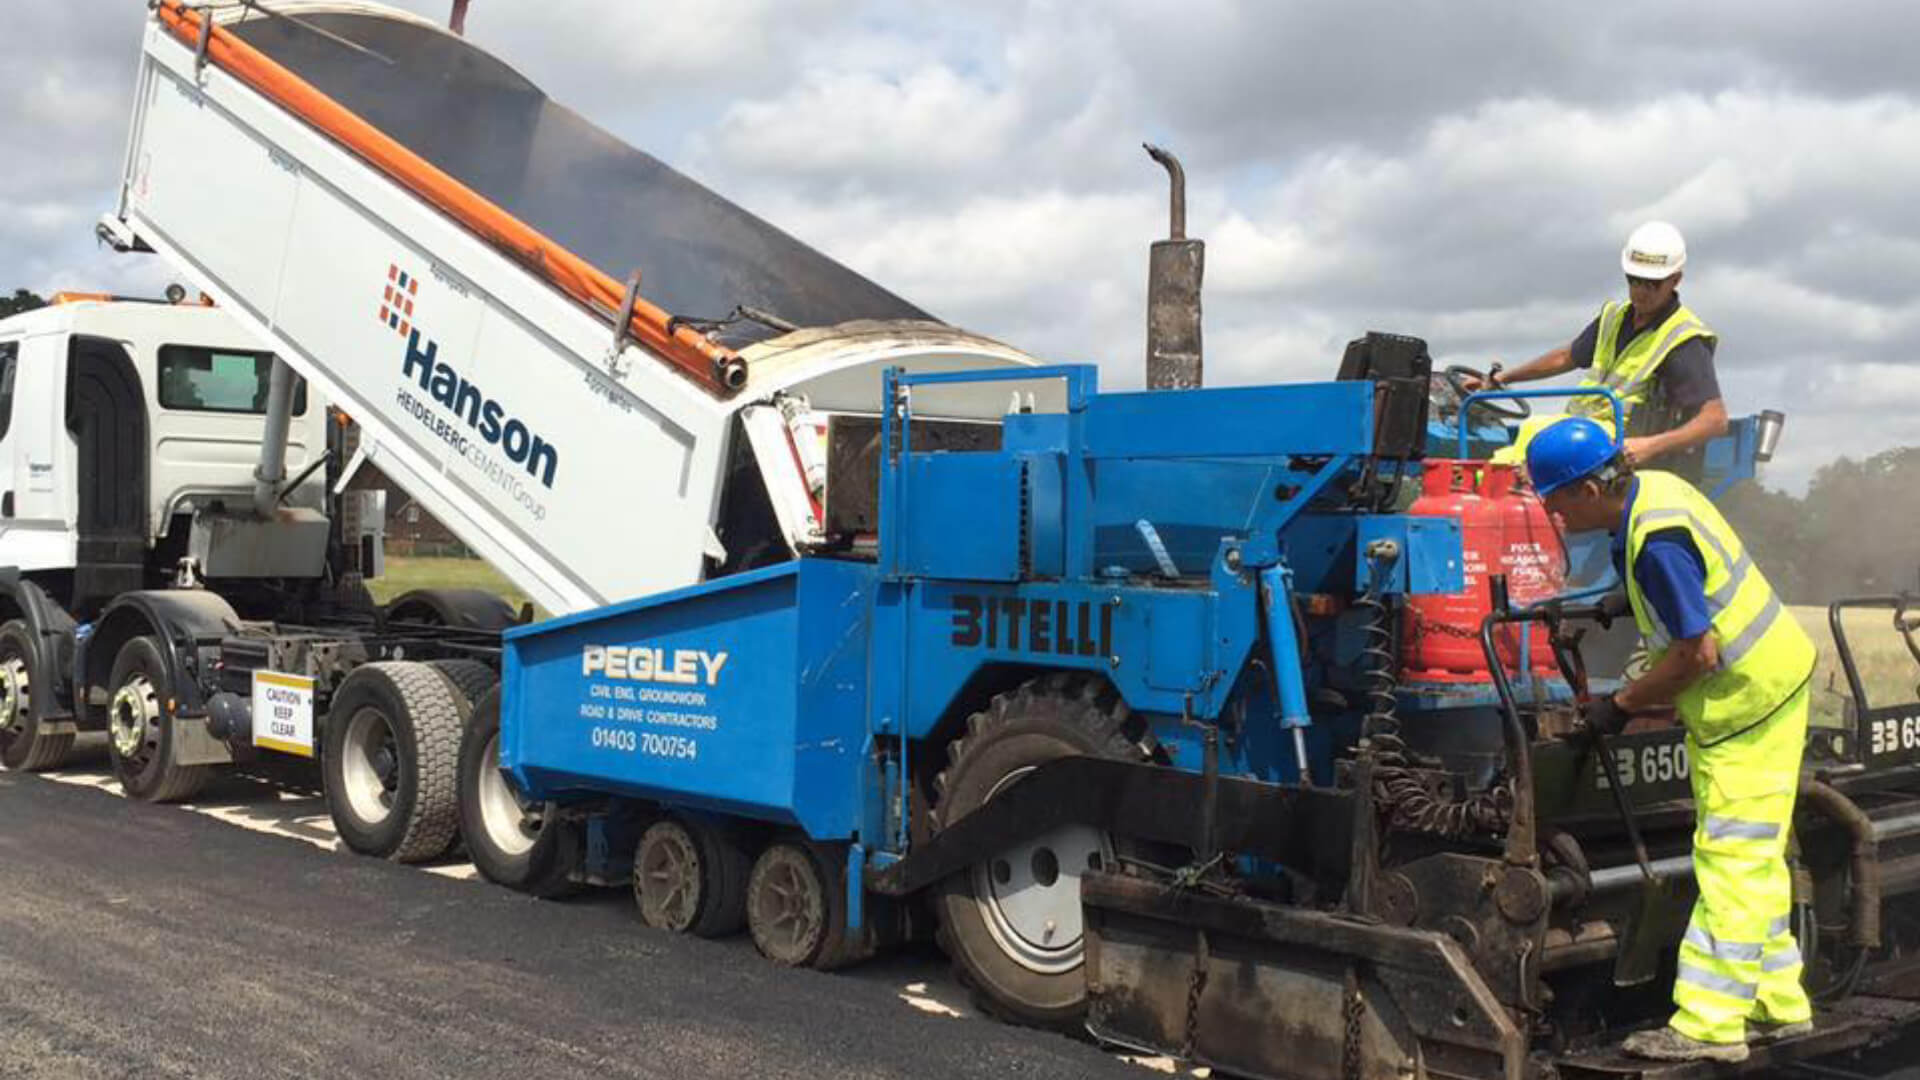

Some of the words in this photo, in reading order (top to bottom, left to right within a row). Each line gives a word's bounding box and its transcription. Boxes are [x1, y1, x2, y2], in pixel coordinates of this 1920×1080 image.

[403, 327, 558, 488] Hanson
[951, 594, 1113, 658] BITELLI
[582, 644, 728, 686] PEGLEY
[266, 688, 301, 705] CAUTION
[590, 684, 611, 699] CIVIL
[639, 688, 706, 707] GROUNDWORK
[274, 706, 294, 720] KEEP
[580, 703, 605, 718] ROAD
[608, 706, 615, 719] &
[617, 707, 643, 722] DRIVE
[647, 711, 717, 731] CONTRACTORS
[271, 721, 296, 736] CLEAR
[592, 727, 637, 752] 01403
[641, 733, 697, 760] 700754
[1641, 743, 1689, 784] 650
